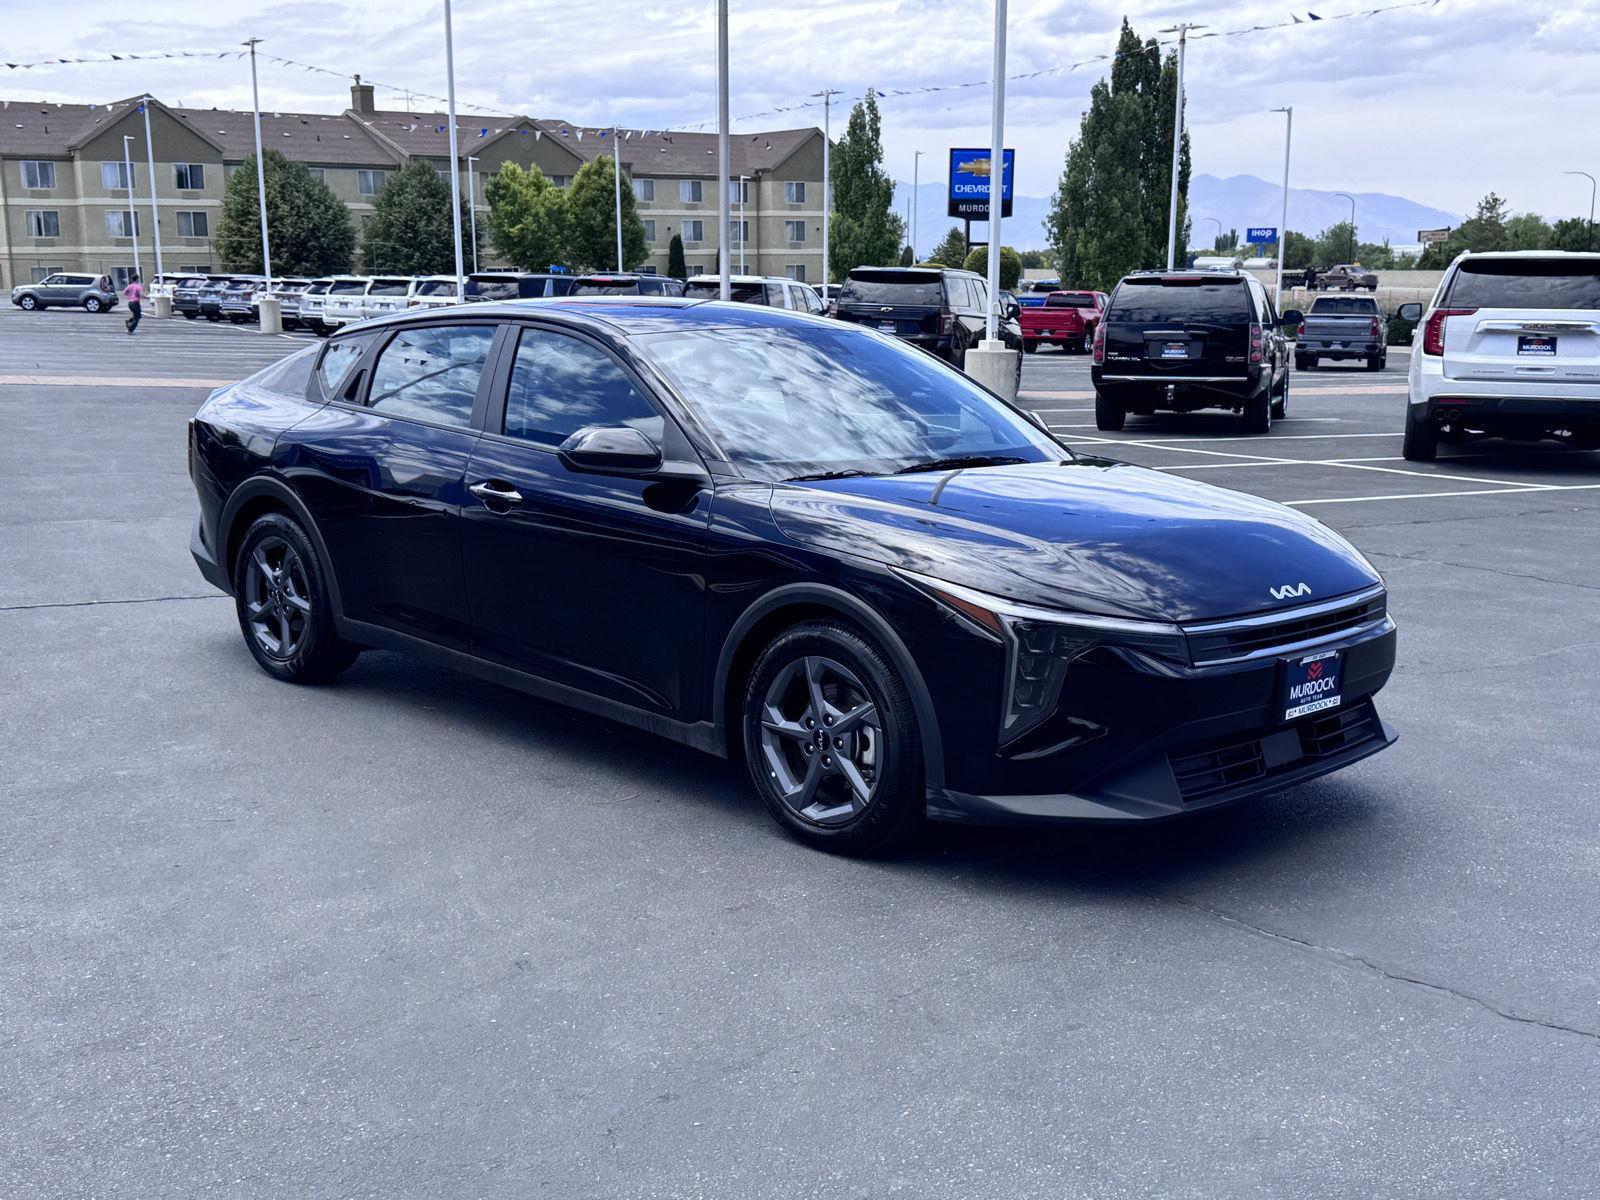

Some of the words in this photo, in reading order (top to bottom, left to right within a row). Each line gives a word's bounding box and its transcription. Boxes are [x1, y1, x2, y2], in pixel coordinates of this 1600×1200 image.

[954, 184, 1008, 193] CHEVROT
[958, 204, 991, 213] MURDO
[1290, 675, 1336, 700] MURDOCK
[1298, 699, 1329, 715] MURDOCK
